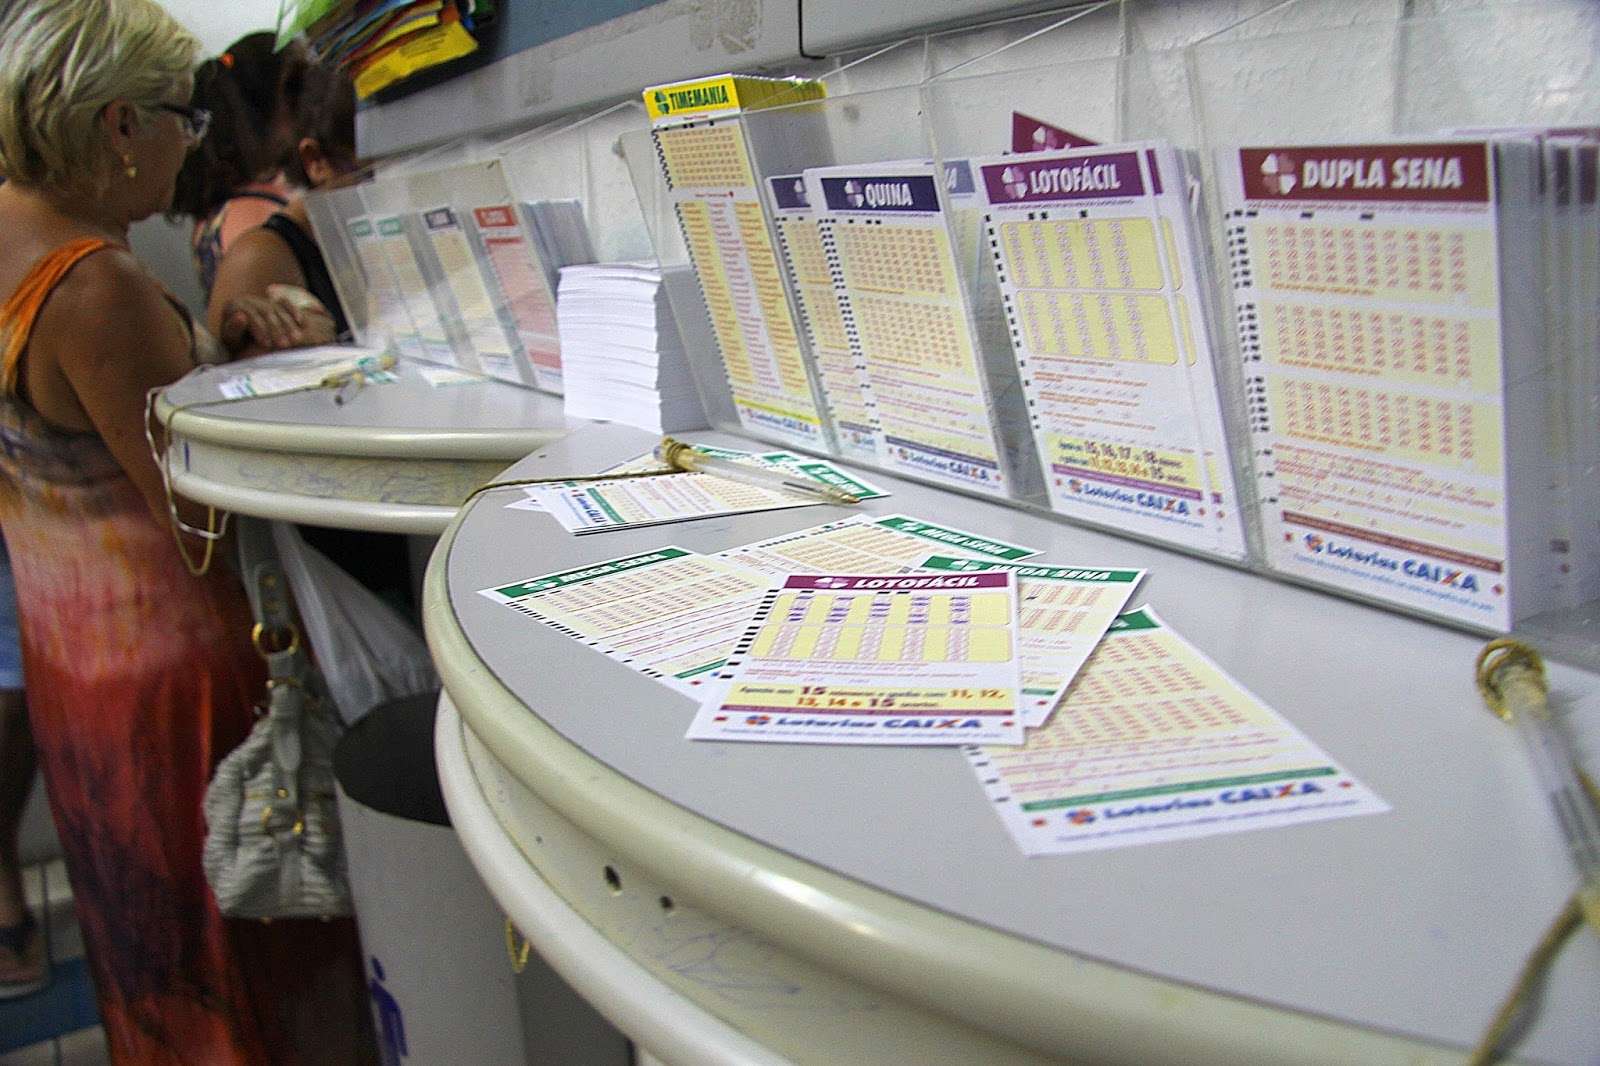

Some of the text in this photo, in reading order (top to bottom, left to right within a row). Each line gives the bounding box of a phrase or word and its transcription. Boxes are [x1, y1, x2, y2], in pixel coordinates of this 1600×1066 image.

[669, 85, 729, 110] TIMEMANIA
[1029, 158, 1121, 194] LOTOFÁCIL
[1302, 157, 1462, 189] DUPLA SENA
[864, 182, 914, 208] QUINA
[1137, 493, 1191, 516] CAIXA
[1327, 541, 1399, 571] Loterias
[1402, 559, 1480, 593] CAIXA
[852, 576, 980, 588] LOTOFÁCIL
[801, 686, 827, 695] 15
[869, 698, 895, 708] 15
[777, 717, 982, 729] Loterias CAIXA
[1104, 783, 1325, 818] Loterias CAIXA
